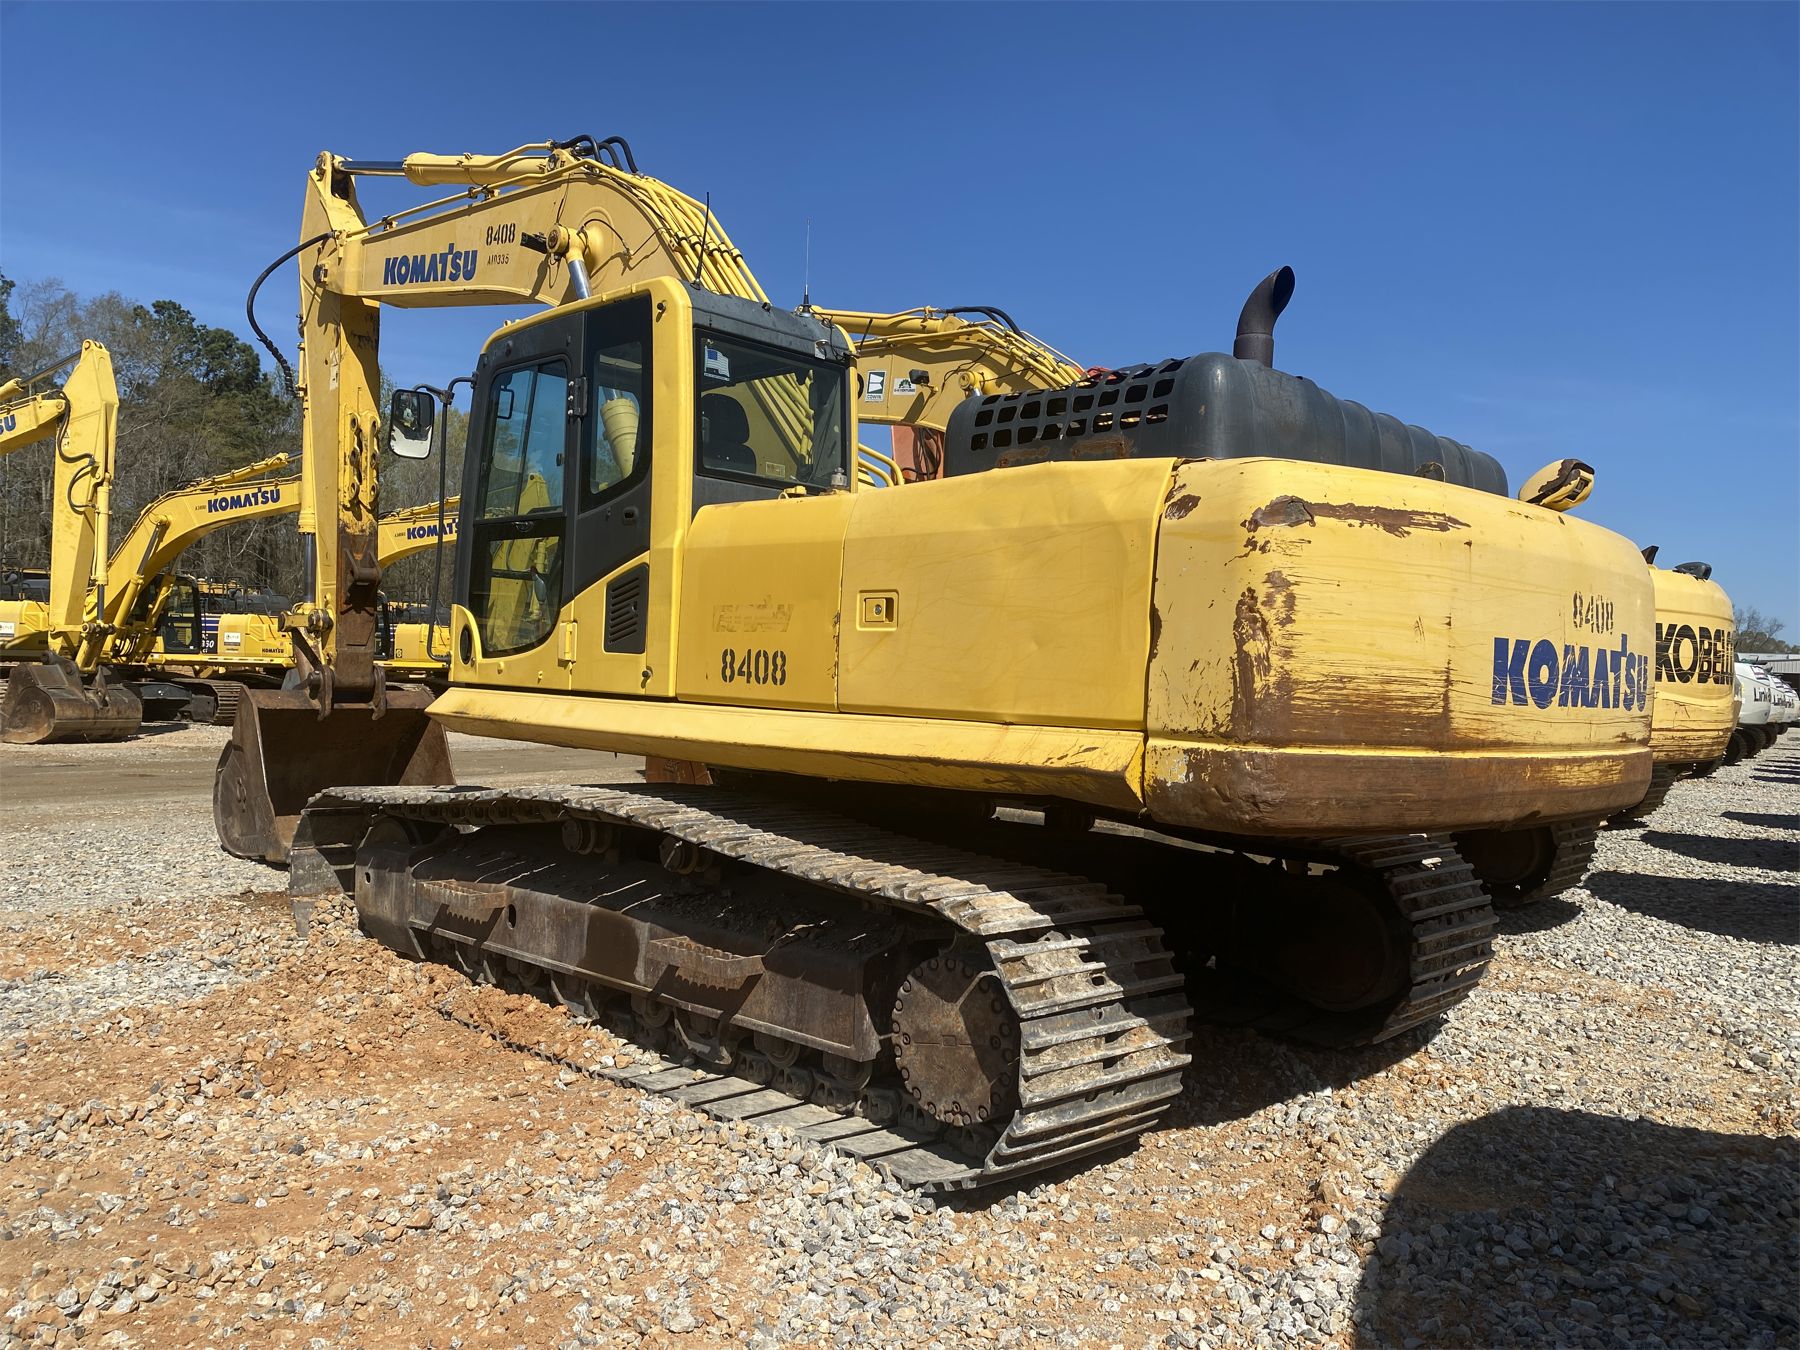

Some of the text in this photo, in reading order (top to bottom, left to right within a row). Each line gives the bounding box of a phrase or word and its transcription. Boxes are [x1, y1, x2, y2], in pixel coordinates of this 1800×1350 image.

[485, 223, 516, 246] 8408
[383, 243, 478, 285] KOMATSU
[207, 487, 280, 513] KOMATSU
[1573, 590, 1614, 635] 8408
[721, 648, 787, 686] 8408
[1491, 633, 1648, 712] KOMATSU
